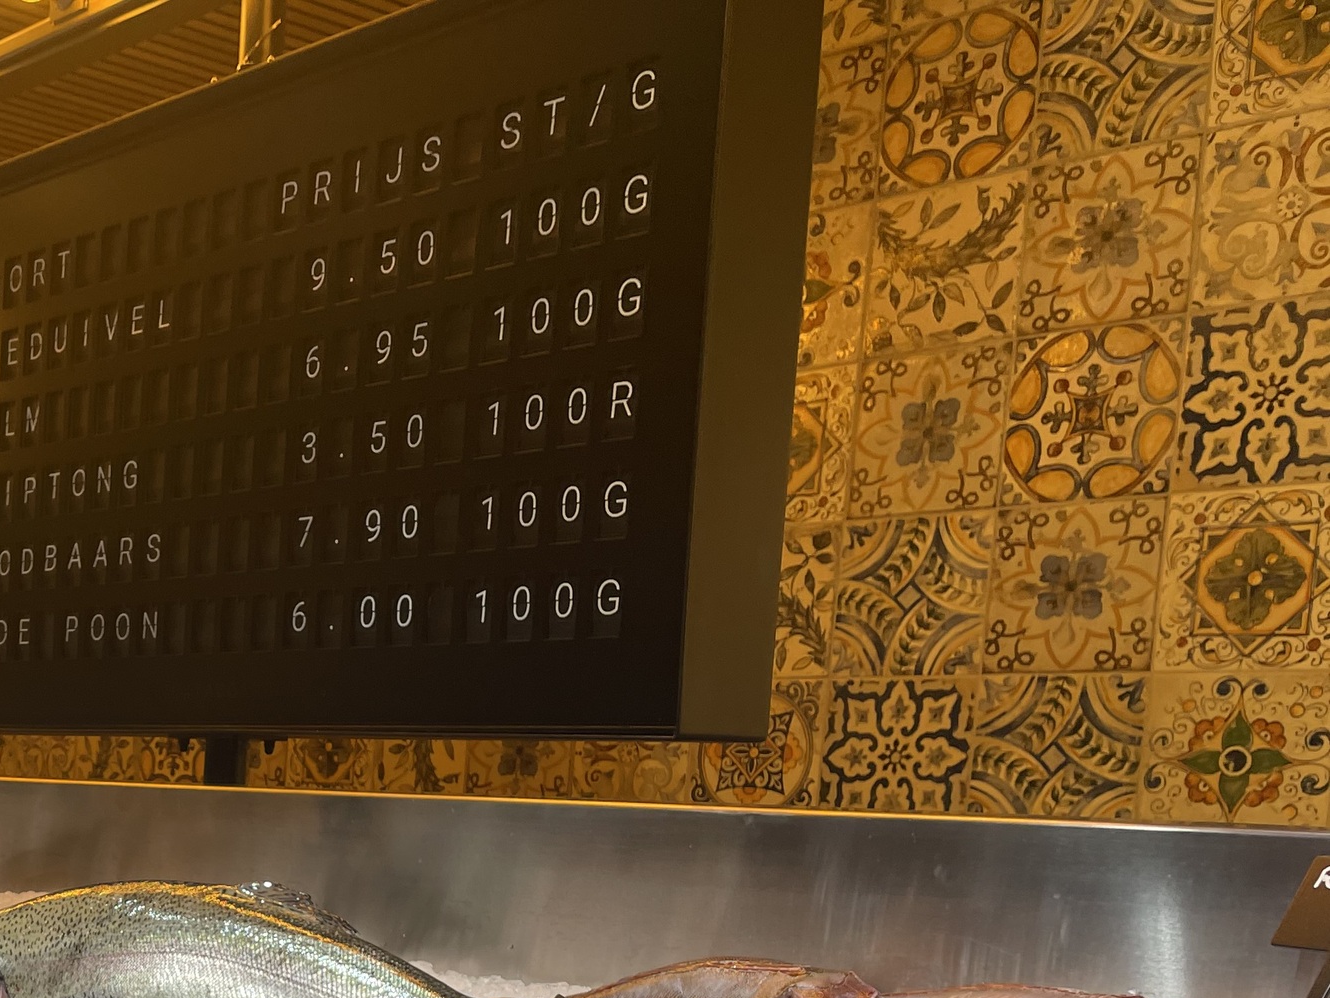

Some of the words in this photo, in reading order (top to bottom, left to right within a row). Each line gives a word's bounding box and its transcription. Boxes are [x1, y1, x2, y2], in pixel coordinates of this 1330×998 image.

[281, 136, 441, 214] PRIJS
[500, 70, 656, 149] ST/G
[311, 230, 434, 291] 9.50
[500, 174, 649, 245] 100G
[305, 322, 428, 378] 6.95
[493, 277, 642, 341] 100G
[301, 414, 423, 463] 3.50
[488, 380, 633, 435] 100R
[298, 505, 418, 548] 7.90
[482, 480, 627, 531] 100G
[65, 611, 158, 642] POON
[292, 594, 413, 632] 6.00
[475, 578, 620, 624] 100G
